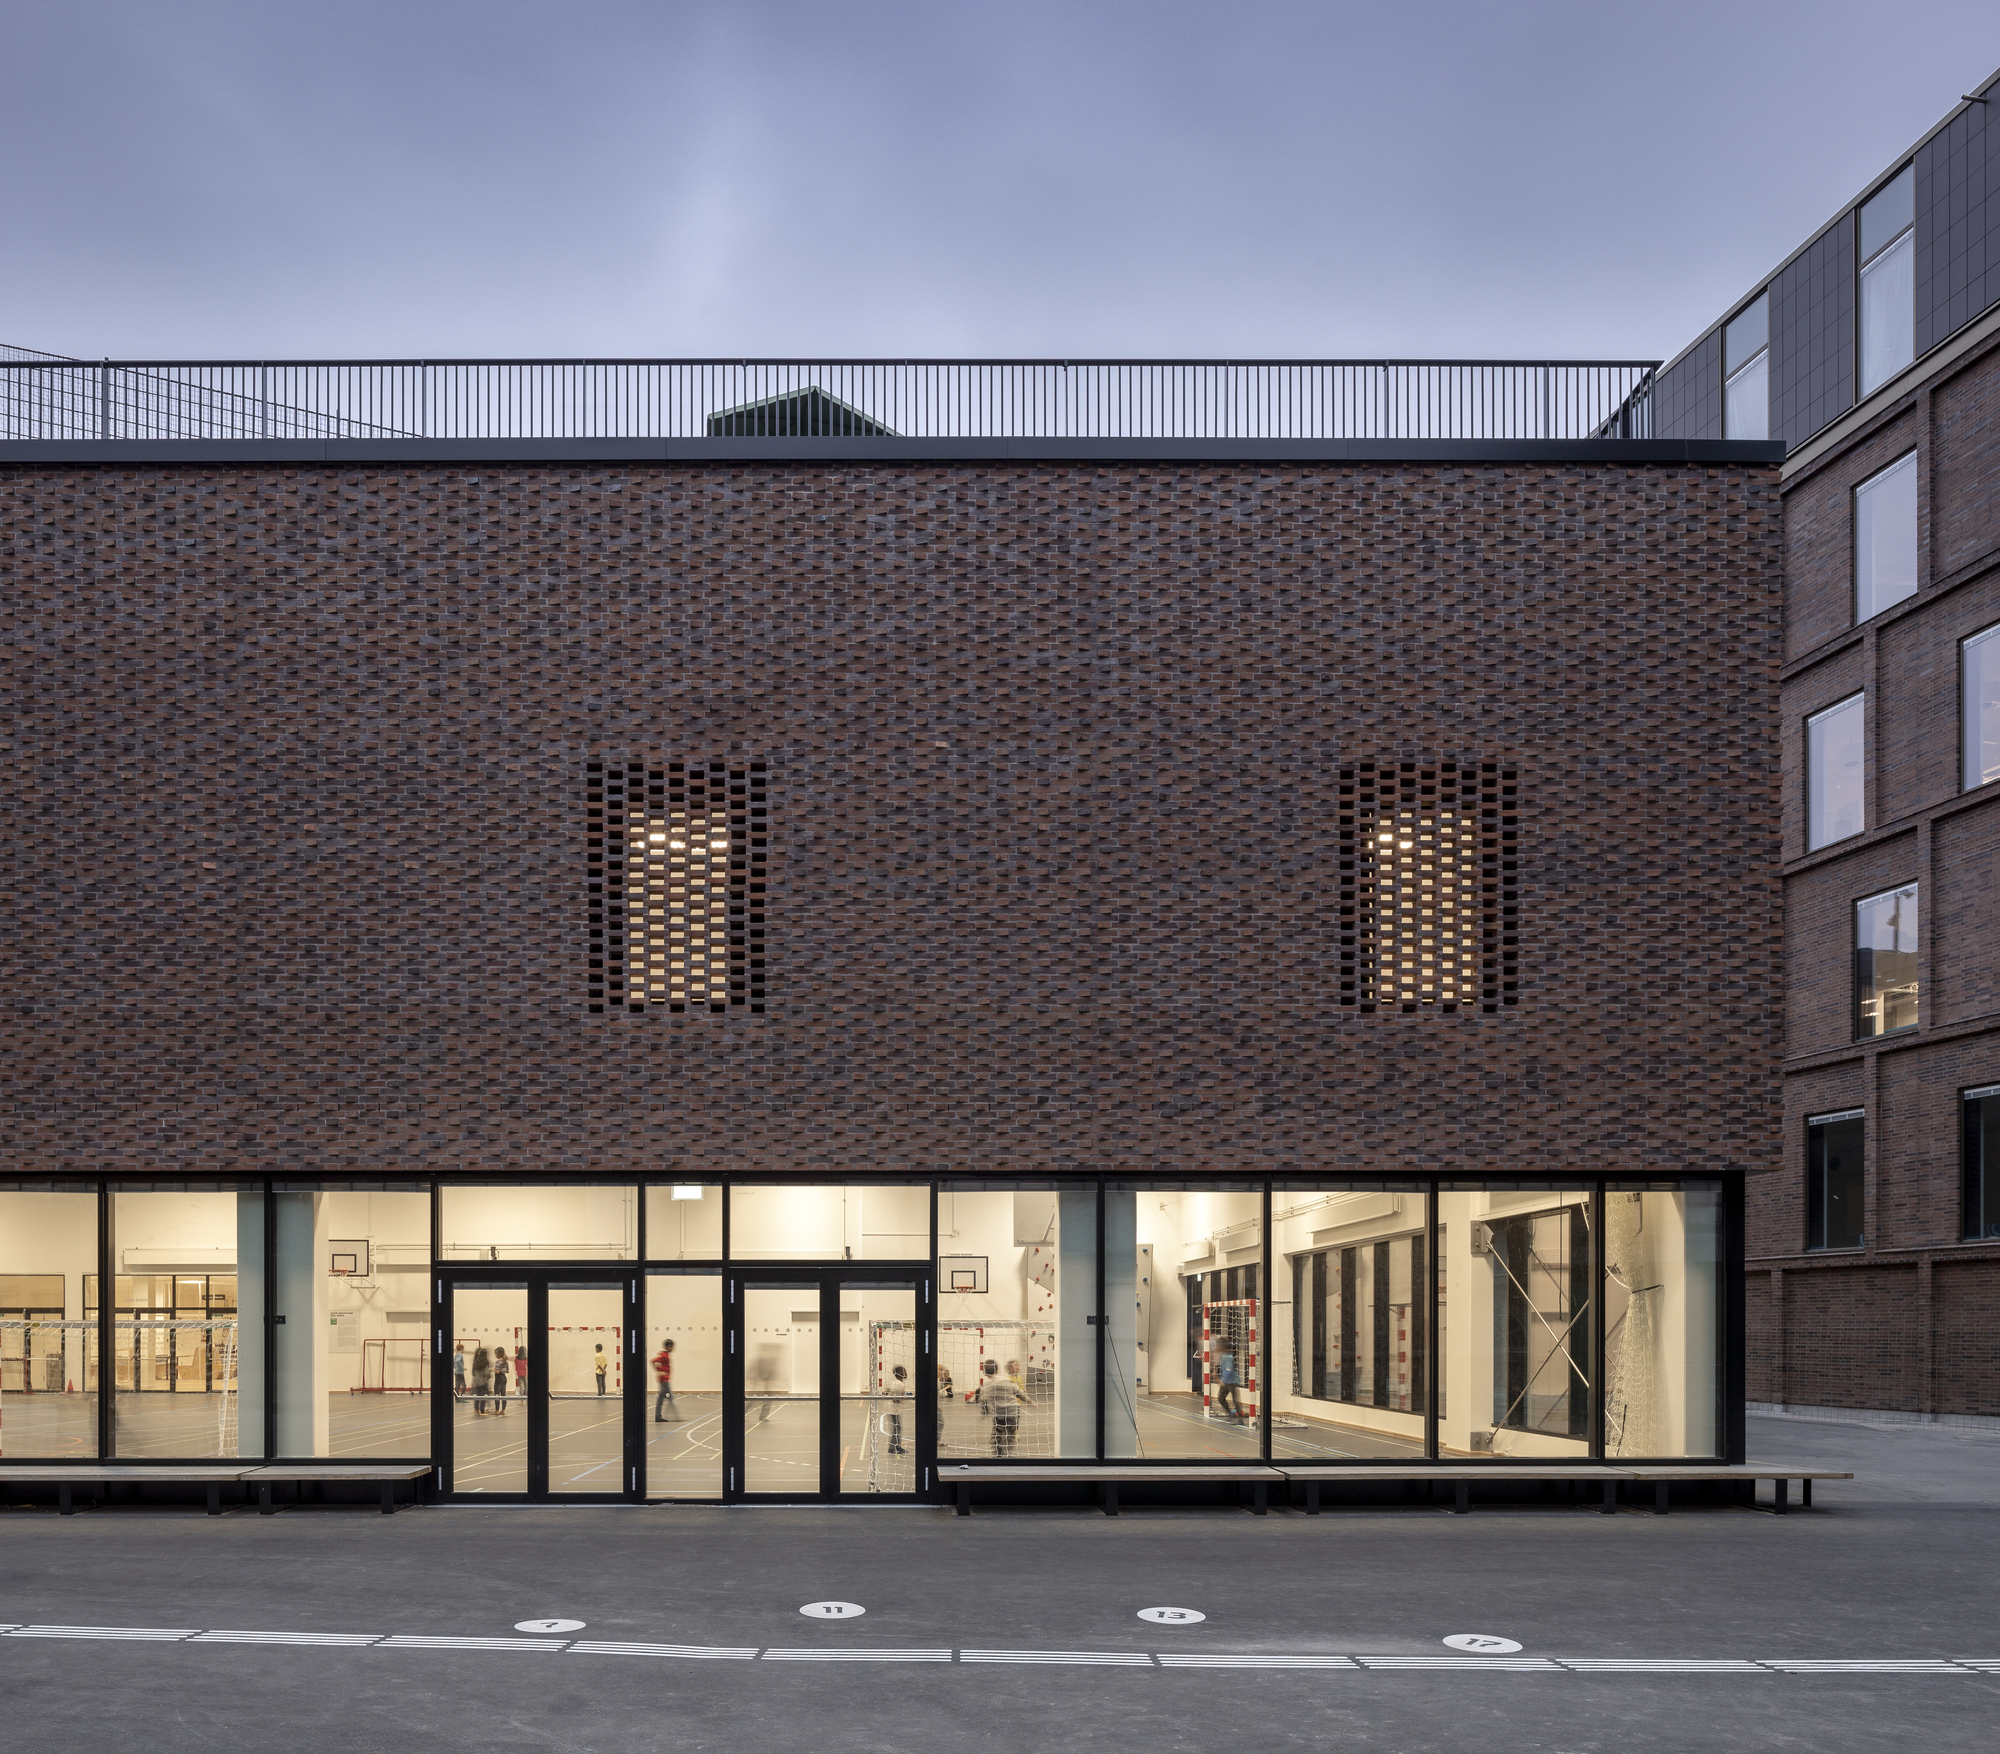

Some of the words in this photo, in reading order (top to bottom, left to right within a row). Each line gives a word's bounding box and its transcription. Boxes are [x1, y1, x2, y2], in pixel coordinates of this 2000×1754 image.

[822, 1606, 843, 1614] 11
[1156, 1610, 1187, 1619] 13
[1466, 1638, 1502, 1647] 17
